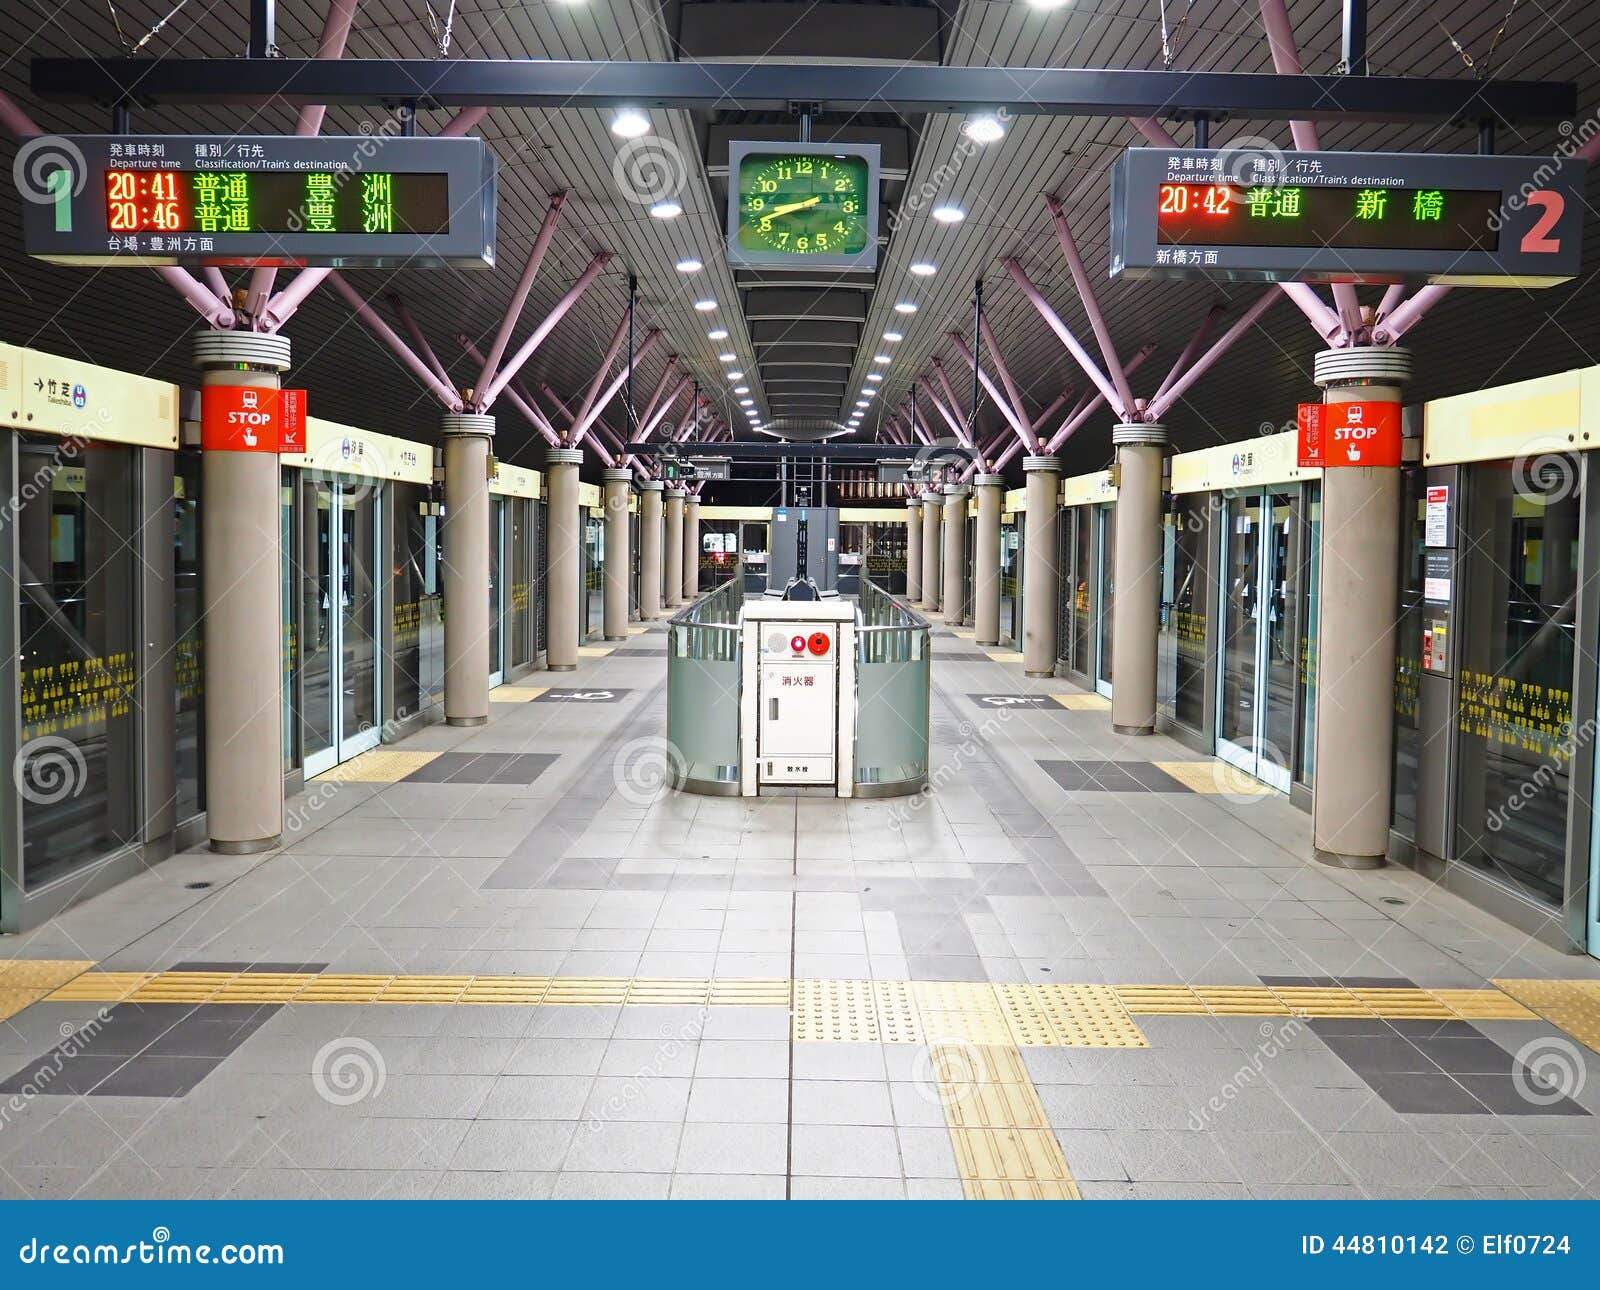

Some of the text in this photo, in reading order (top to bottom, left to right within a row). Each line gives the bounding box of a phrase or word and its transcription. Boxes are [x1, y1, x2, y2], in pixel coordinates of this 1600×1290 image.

[109, 143, 165, 157] 発車時刻
[110, 159, 181, 169] Departure time
[294, 160, 348, 169] destination
[795, 162, 813, 174] 12
[1167, 157, 1223, 171] 発車時刻
[778, 167, 793, 180] 11
[820, 166, 828, 179] 1
[1167, 172, 1239, 183] Departure time
[760, 180, 778, 193] 10
[834, 179, 846, 192] 2
[1351, 175, 1405, 185] destination
[108, 172, 178, 200] 20:41
[193, 172, 250, 203] 普通
[47, 170, 72, 232] 1
[753, 198, 764, 211] 9
[843, 200, 854, 213] 3
[1160, 186, 1231, 214] 20:42
[1245, 187, 1301, 217] 普通
[110, 202, 180, 230] 20:46
[194, 203, 251, 232] 普通
[1520, 190, 1565, 253] 2
[760, 219, 772, 232] 8
[833, 220, 845, 233] 4
[778, 232, 790, 245] 7
[797, 237, 809, 250] 6
[815, 233, 827, 246] 5
[1156, 249, 1219, 265] 新橋方面
[228, 411, 271, 426] STOP
[1333, 427, 1378, 440] STOP
[782, 675, 814, 687] 消火器
